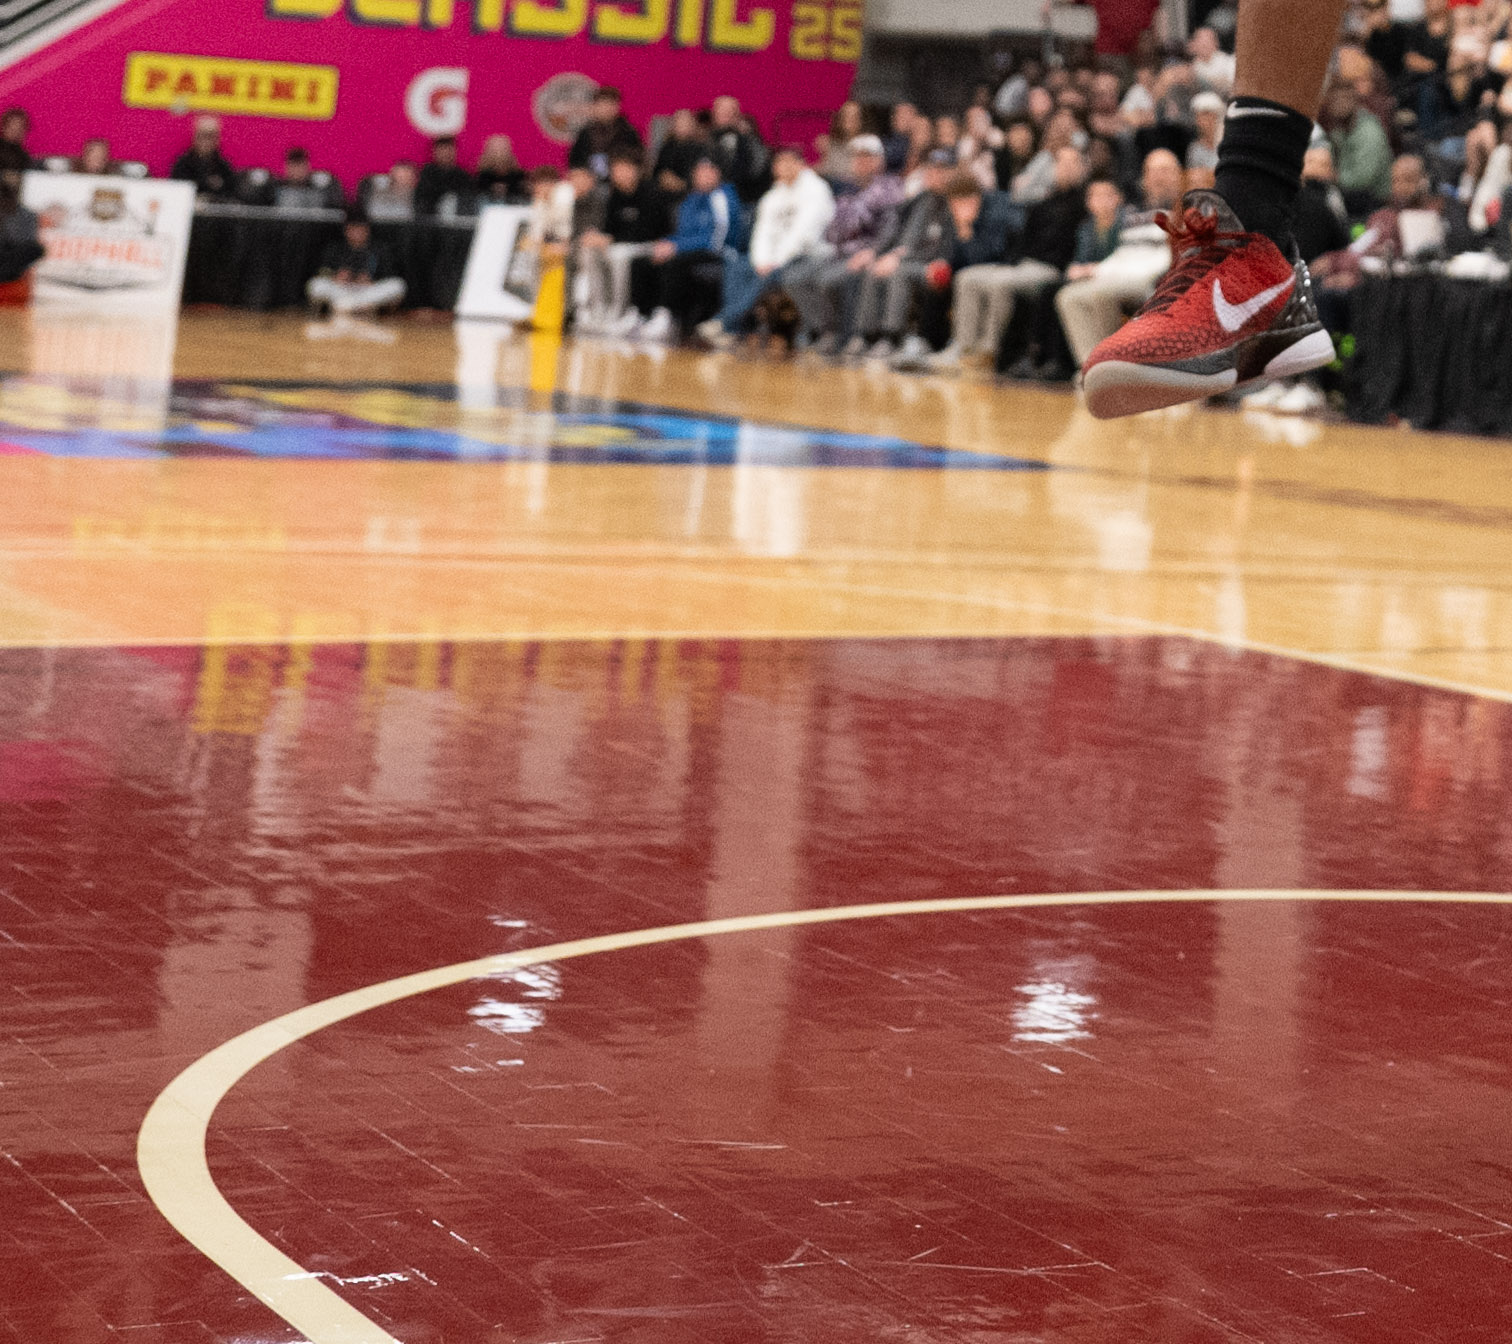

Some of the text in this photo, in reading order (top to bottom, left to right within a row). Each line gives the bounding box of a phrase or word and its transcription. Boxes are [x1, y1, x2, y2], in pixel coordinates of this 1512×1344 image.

[789, 4, 863, 61] 25
[143, 67, 322, 105] PANINI
[404, 67, 469, 136] G
